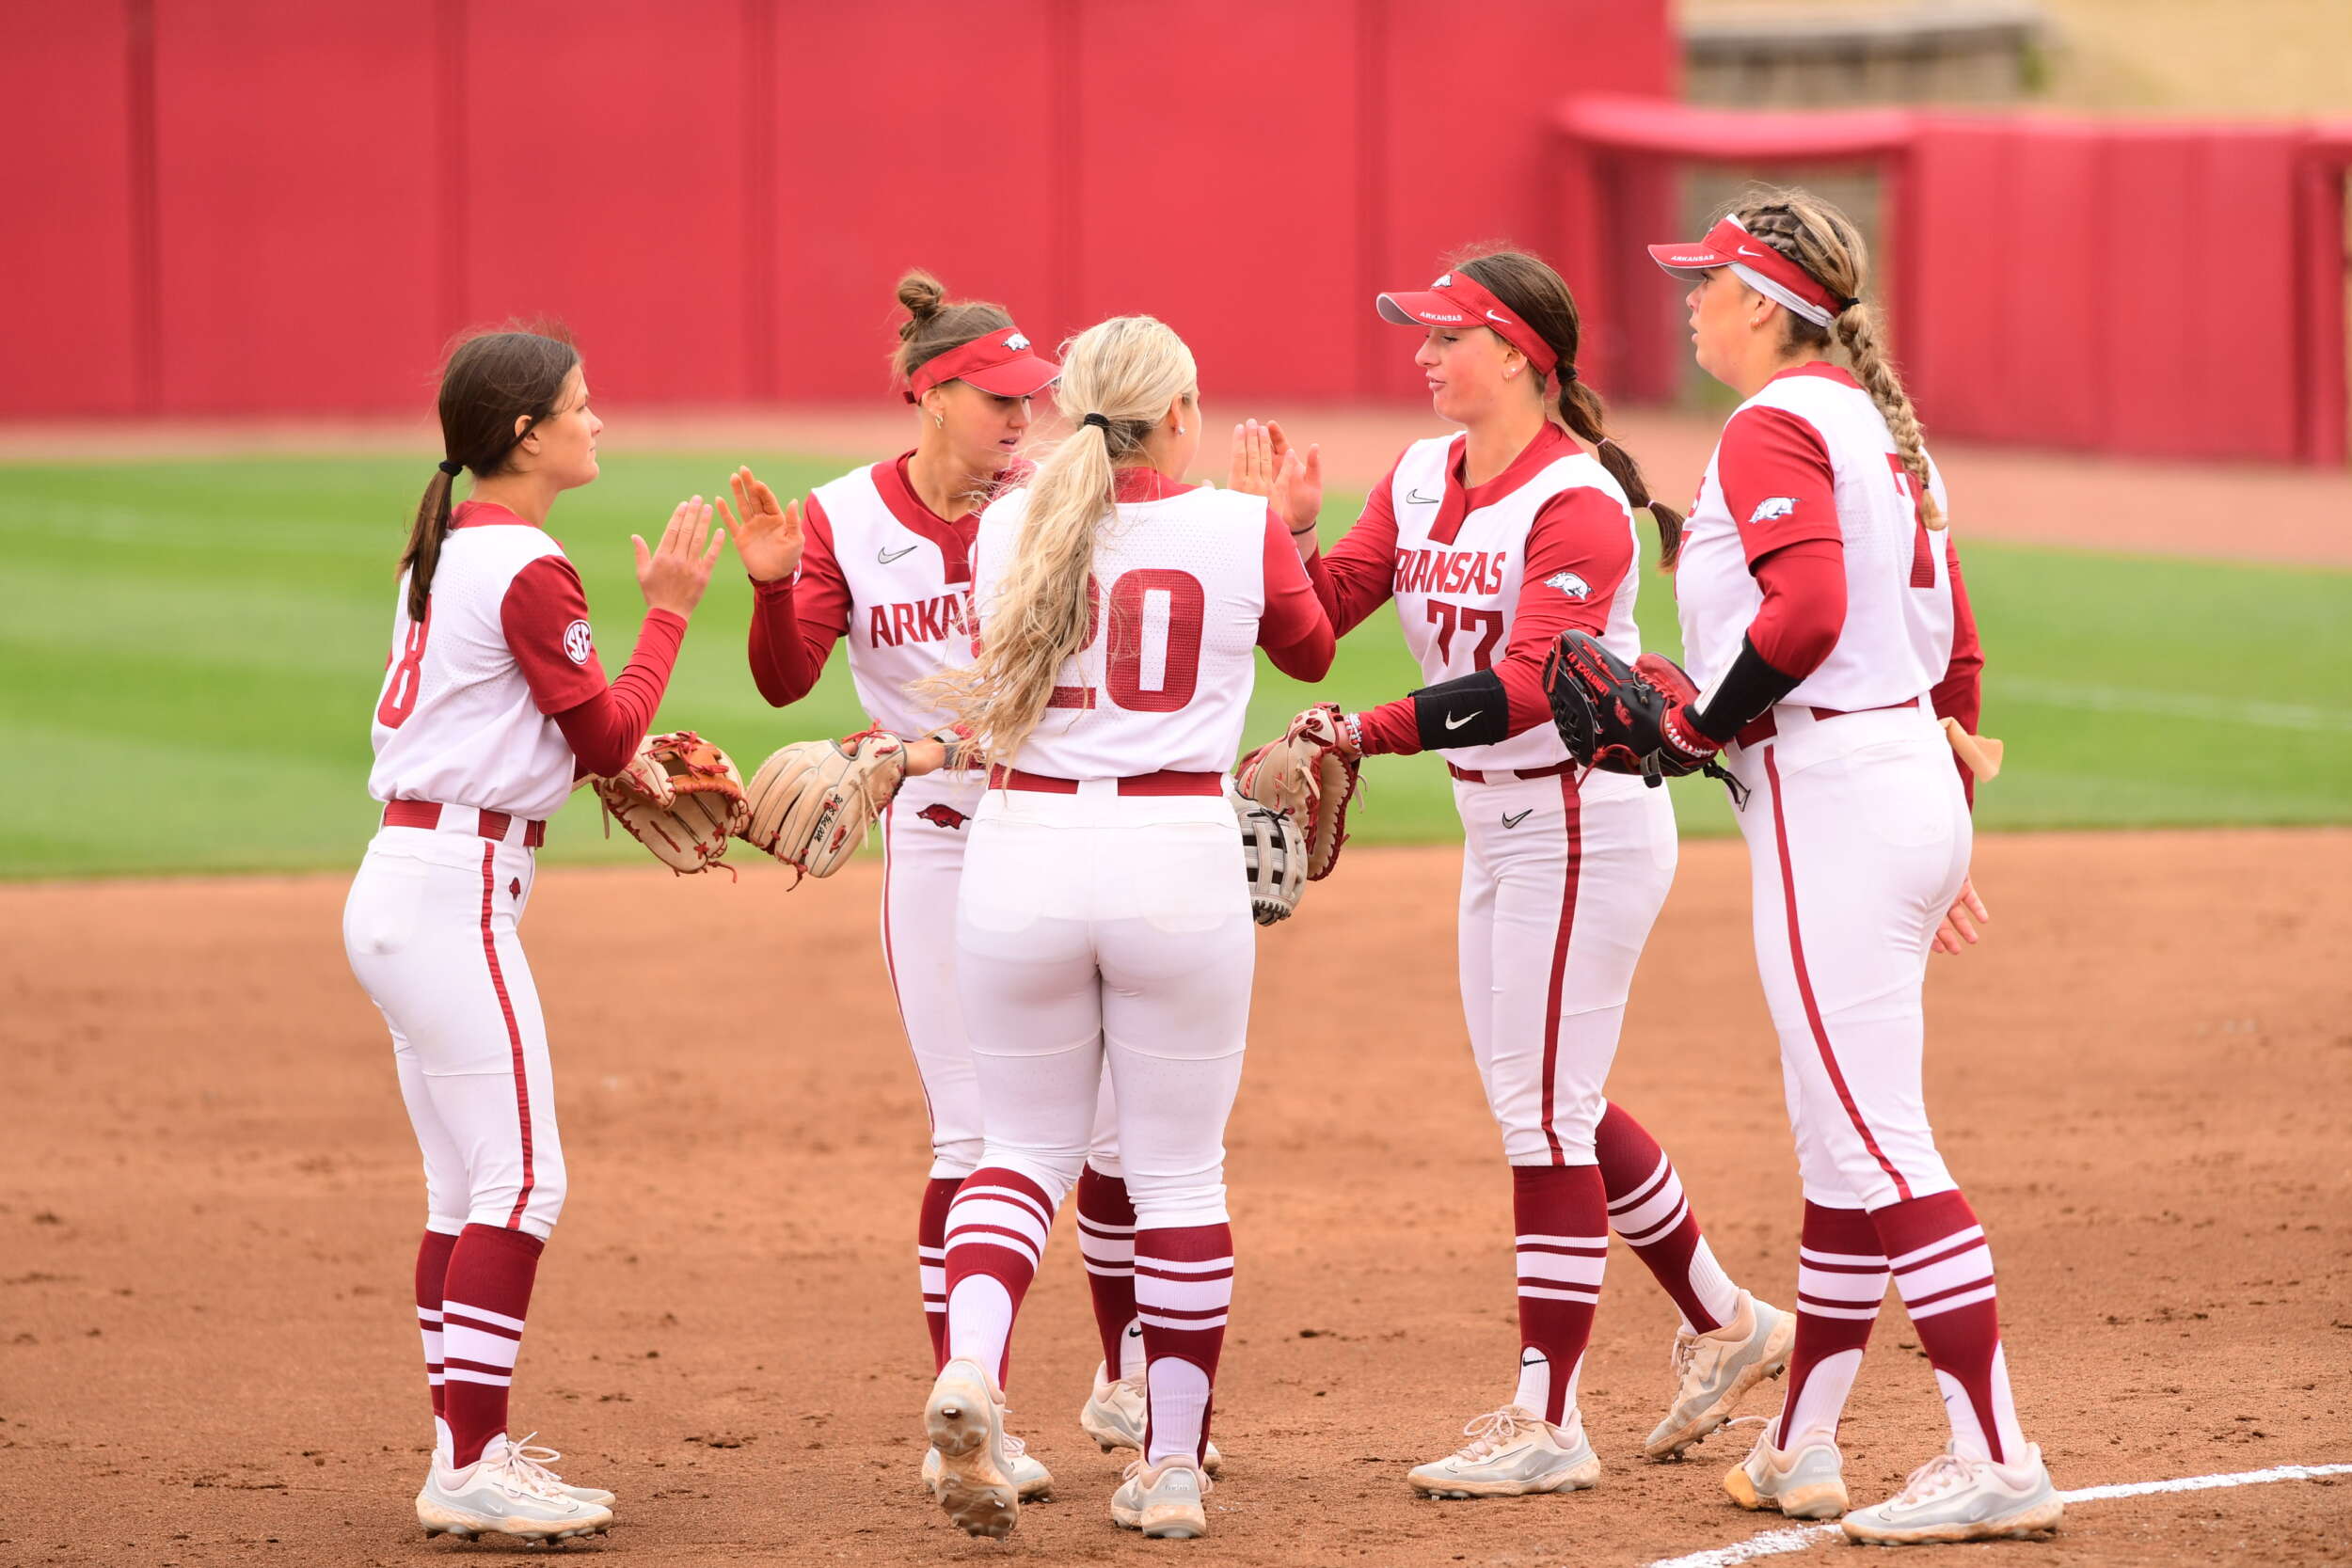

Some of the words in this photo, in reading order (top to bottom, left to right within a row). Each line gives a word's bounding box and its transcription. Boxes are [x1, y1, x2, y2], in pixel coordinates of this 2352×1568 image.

[1419, 311, 1463, 322] ARKANSAS
[566, 623, 591, 662] SEC
[869, 590, 971, 649] ARKA
[1427, 598, 1504, 673] 77
